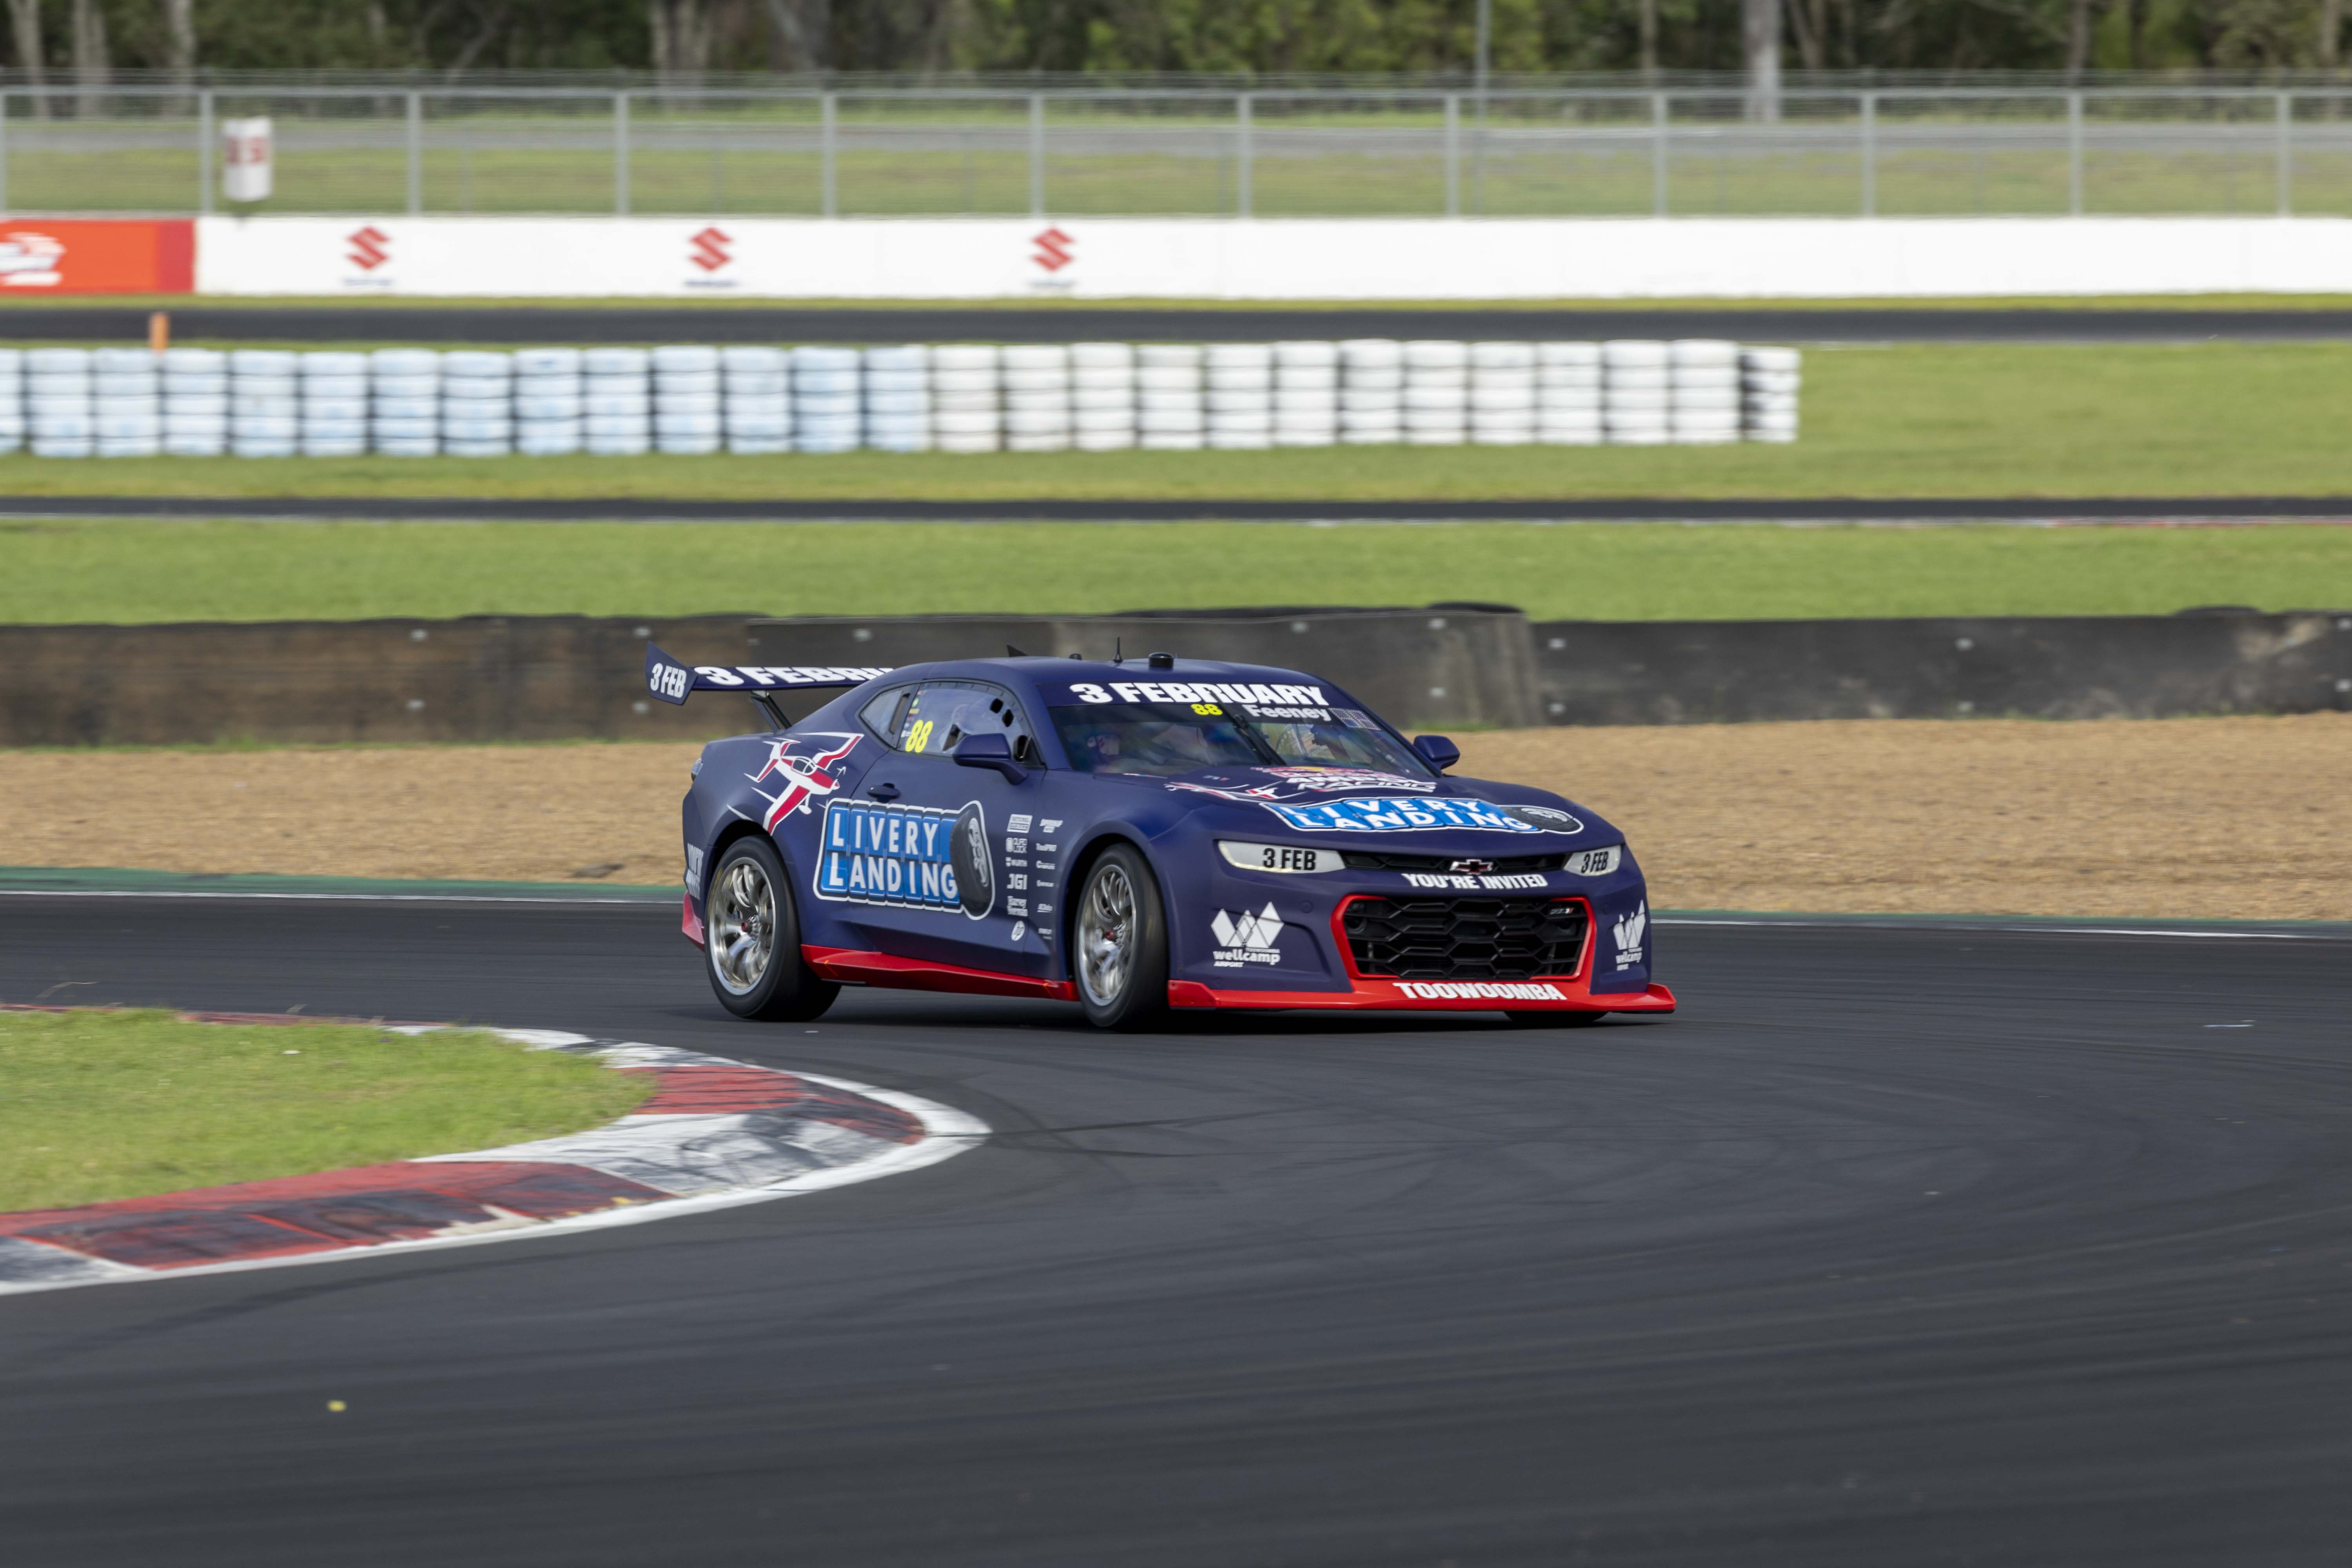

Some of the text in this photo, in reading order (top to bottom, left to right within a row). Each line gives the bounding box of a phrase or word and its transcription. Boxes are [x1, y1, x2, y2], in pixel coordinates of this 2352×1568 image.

[650, 663, 687, 699] 3 FEB
[694, 666, 744, 685] 3
[1069, 682, 1329, 706] 3 FEBRUARY
[1191, 703, 1332, 721] 88 Feeney
[906, 720, 933, 753] 88
[1297, 781, 1436, 790] RACING
[1279, 799, 1483, 818] LIVERY
[1294, 810, 1533, 830] LANDING
[832, 813, 937, 857] LIVERY
[1263, 848, 1316, 871] 3 FEB
[1581, 852, 1609, 873] 3 FEB
[829, 851, 958, 899] LANDING
[1007, 873, 1028, 890] JGI
[1401, 873, 1548, 889] YOU'RE INVITED
[1212, 948, 1281, 965] wellcamp
[1392, 982, 1568, 1000] TOOWOOMBA
